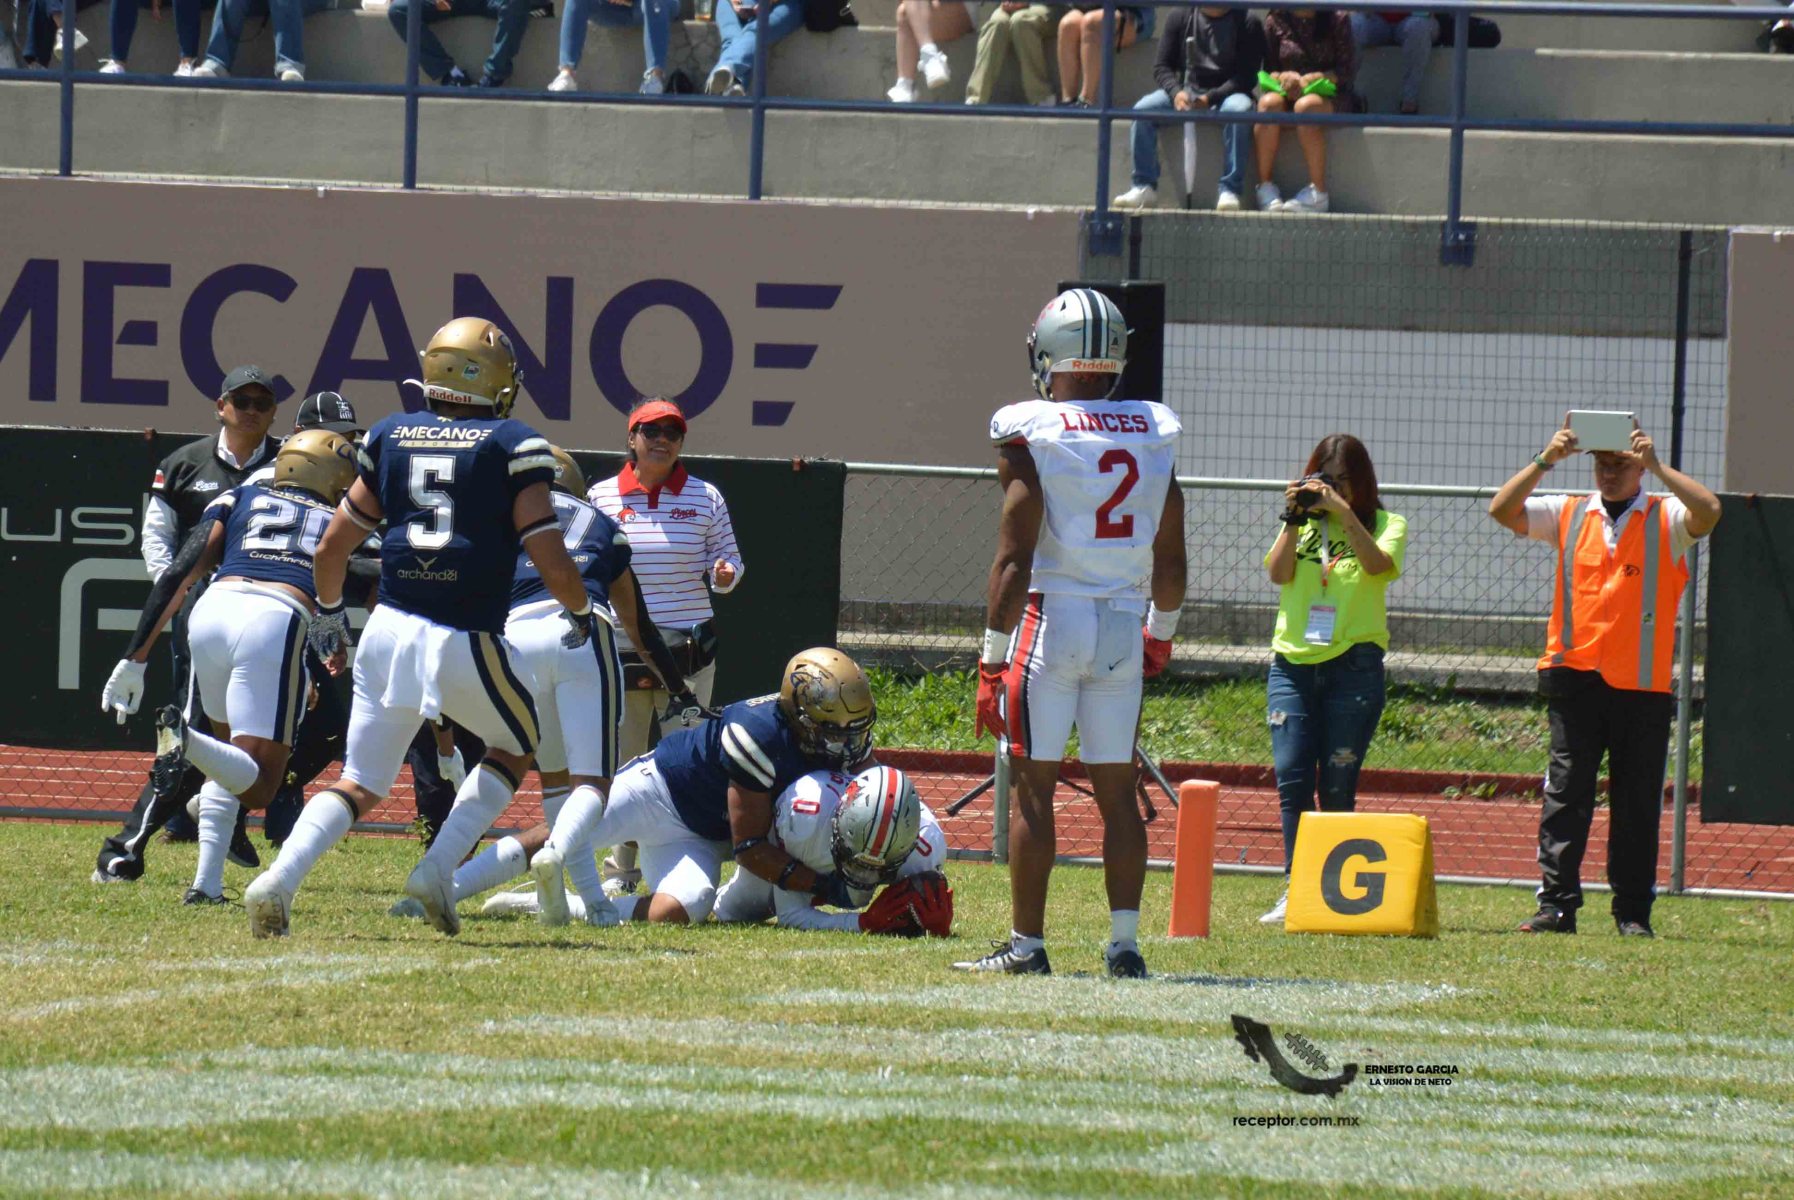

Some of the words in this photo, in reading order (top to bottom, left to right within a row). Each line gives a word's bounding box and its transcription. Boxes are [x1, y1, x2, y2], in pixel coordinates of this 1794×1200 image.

[1071, 359, 1117, 371] Riddell
[429, 388, 472, 404] Riddell
[399, 426, 482, 440] MECANO
[1059, 413, 1149, 433] LINCES
[406, 454, 457, 550] 5
[1095, 448, 1140, 540] 2
[1320, 838, 1388, 916] G
